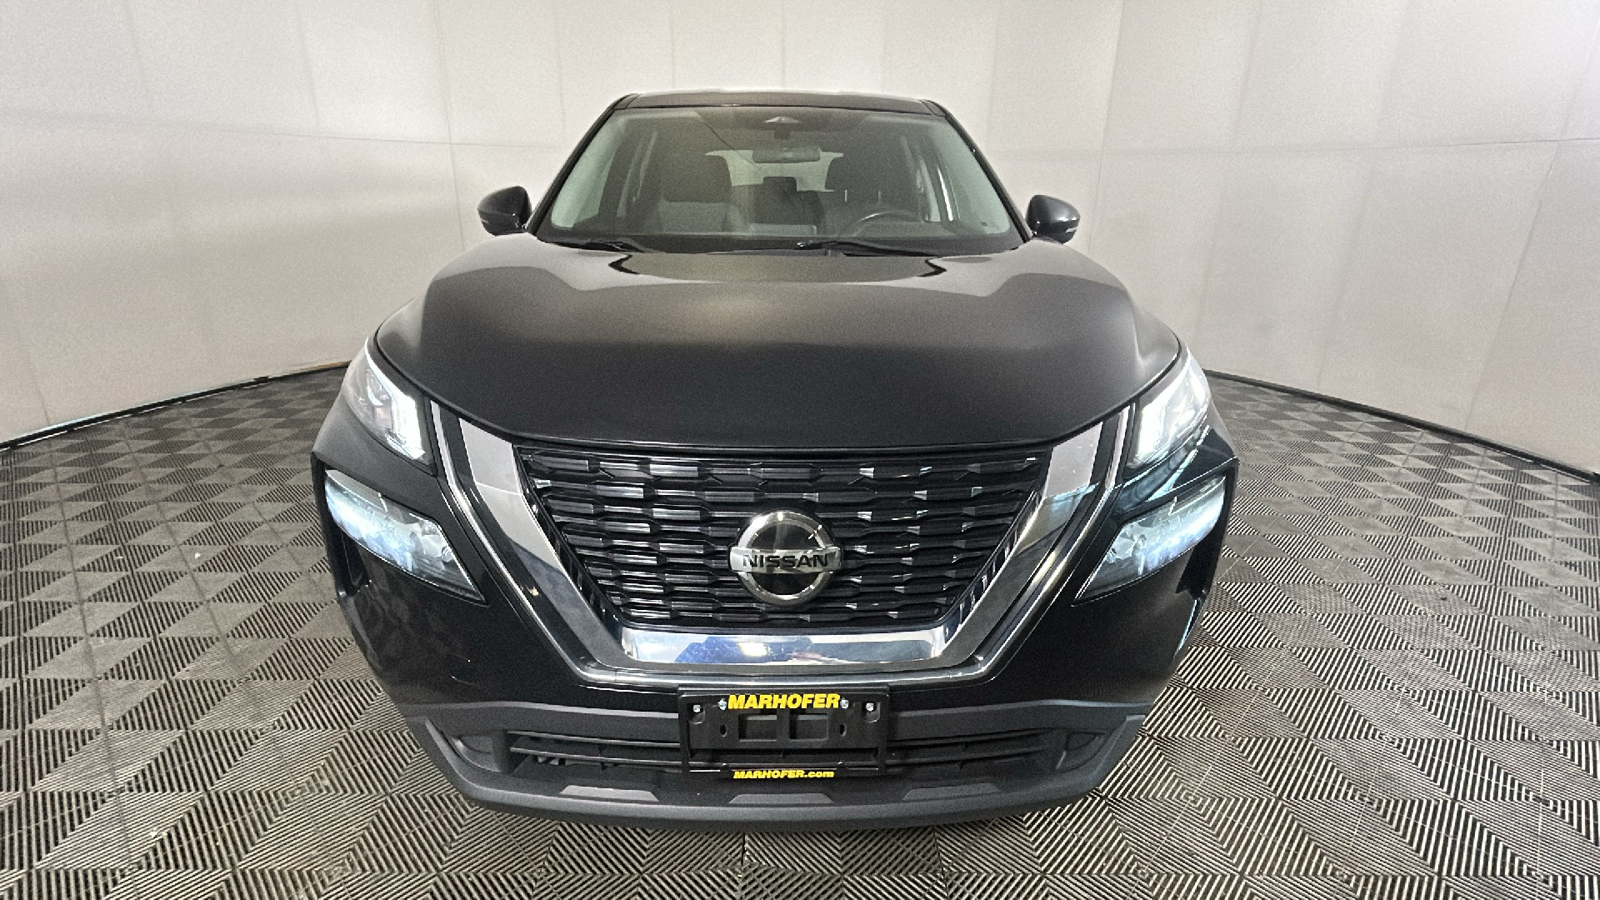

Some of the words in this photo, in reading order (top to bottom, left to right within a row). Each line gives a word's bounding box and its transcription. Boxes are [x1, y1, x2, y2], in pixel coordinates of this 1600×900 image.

[742, 554, 828, 568] NISSAN
[728, 694, 840, 710] MARHOFER
[733, 770, 835, 780] MARHOFER.com
